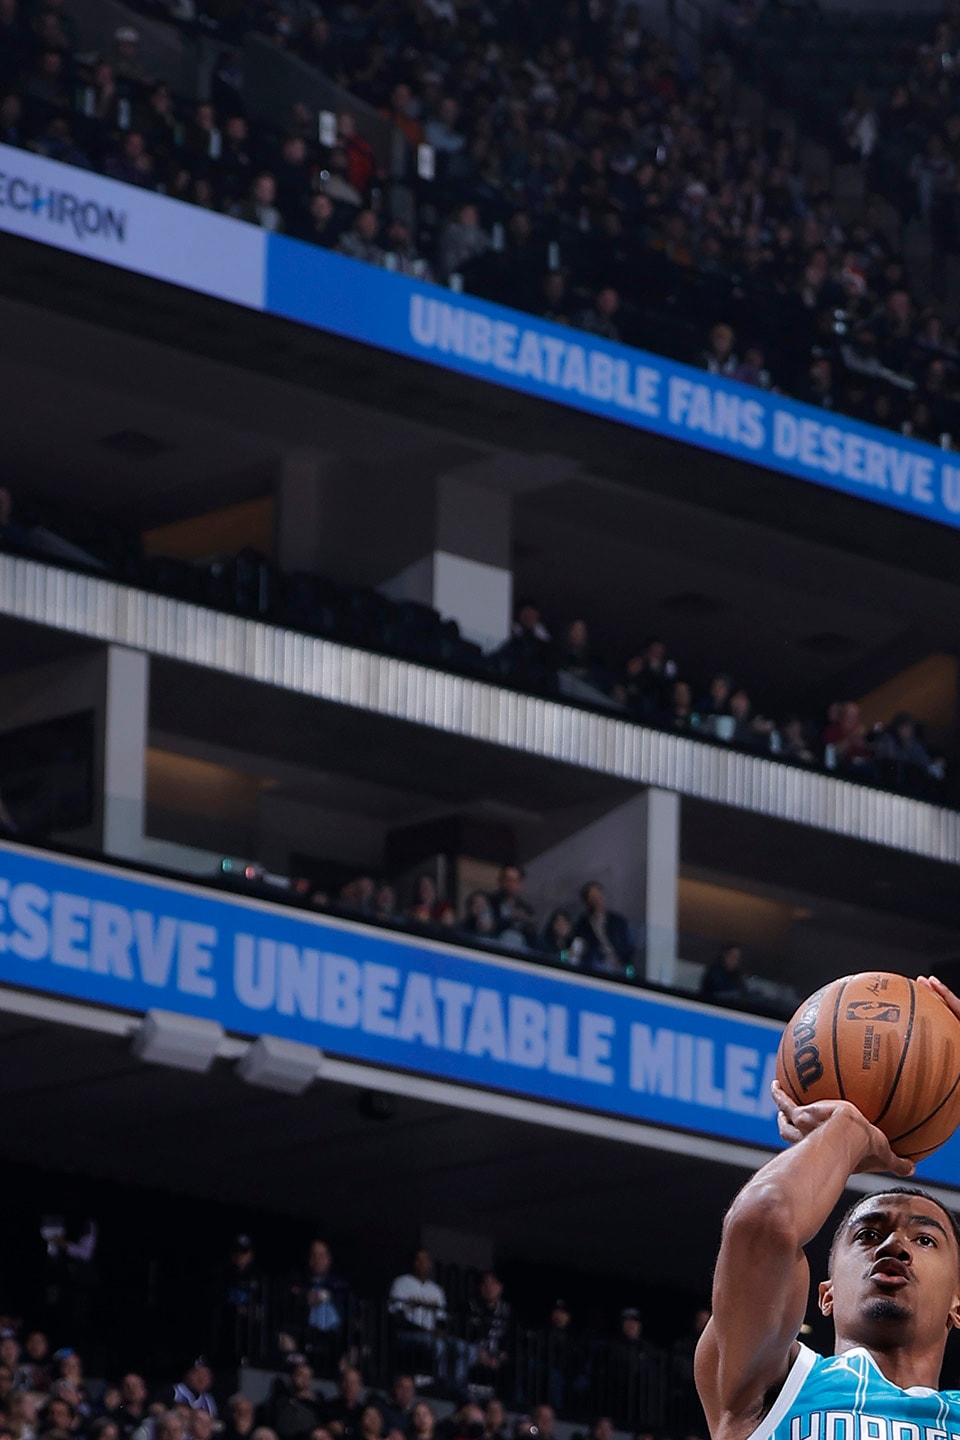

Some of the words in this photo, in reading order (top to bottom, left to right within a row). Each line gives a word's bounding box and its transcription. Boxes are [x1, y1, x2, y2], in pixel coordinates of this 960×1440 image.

[0, 173, 127, 244] CHRON
[409, 293, 661, 417] UNBEATABLE
[669, 375, 765, 450] FANS
[774, 410, 935, 504] DESERVE
[233, 932, 615, 1086] UNBEATABLE
